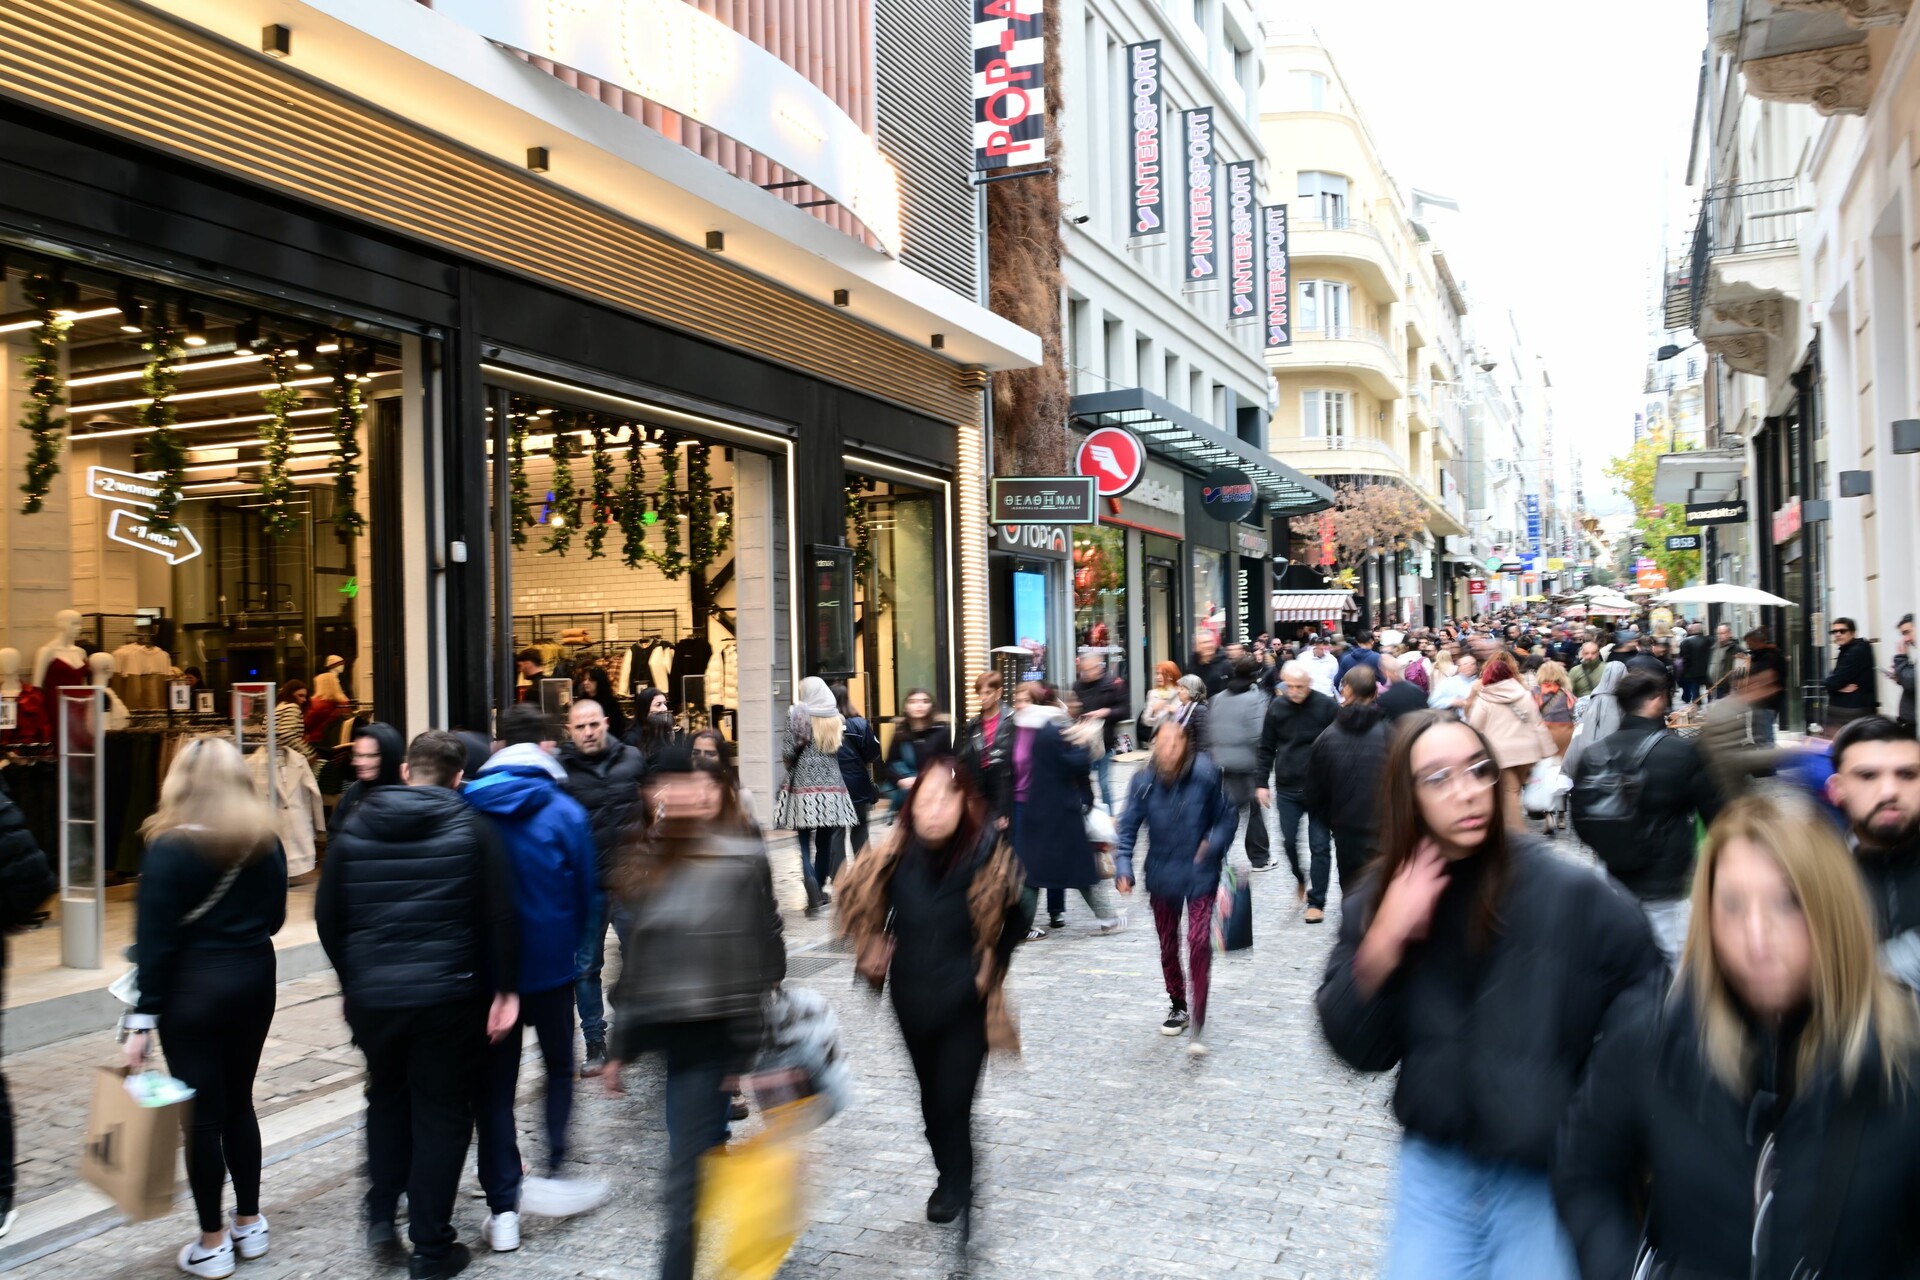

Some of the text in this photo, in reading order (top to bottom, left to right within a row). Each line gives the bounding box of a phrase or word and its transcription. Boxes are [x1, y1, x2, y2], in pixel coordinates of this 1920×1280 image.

[1132, 45, 1159, 207] INTERSPORT
[1187, 111, 1213, 255] INTERSPORT
[1230, 164, 1253, 295] INTERSPORT
[1265, 207, 1288, 326] INTERSPORT
[146, 532, 178, 548] man
[1221, 492, 1253, 503] SPORT
[1669, 536, 1697, 549] BSB
